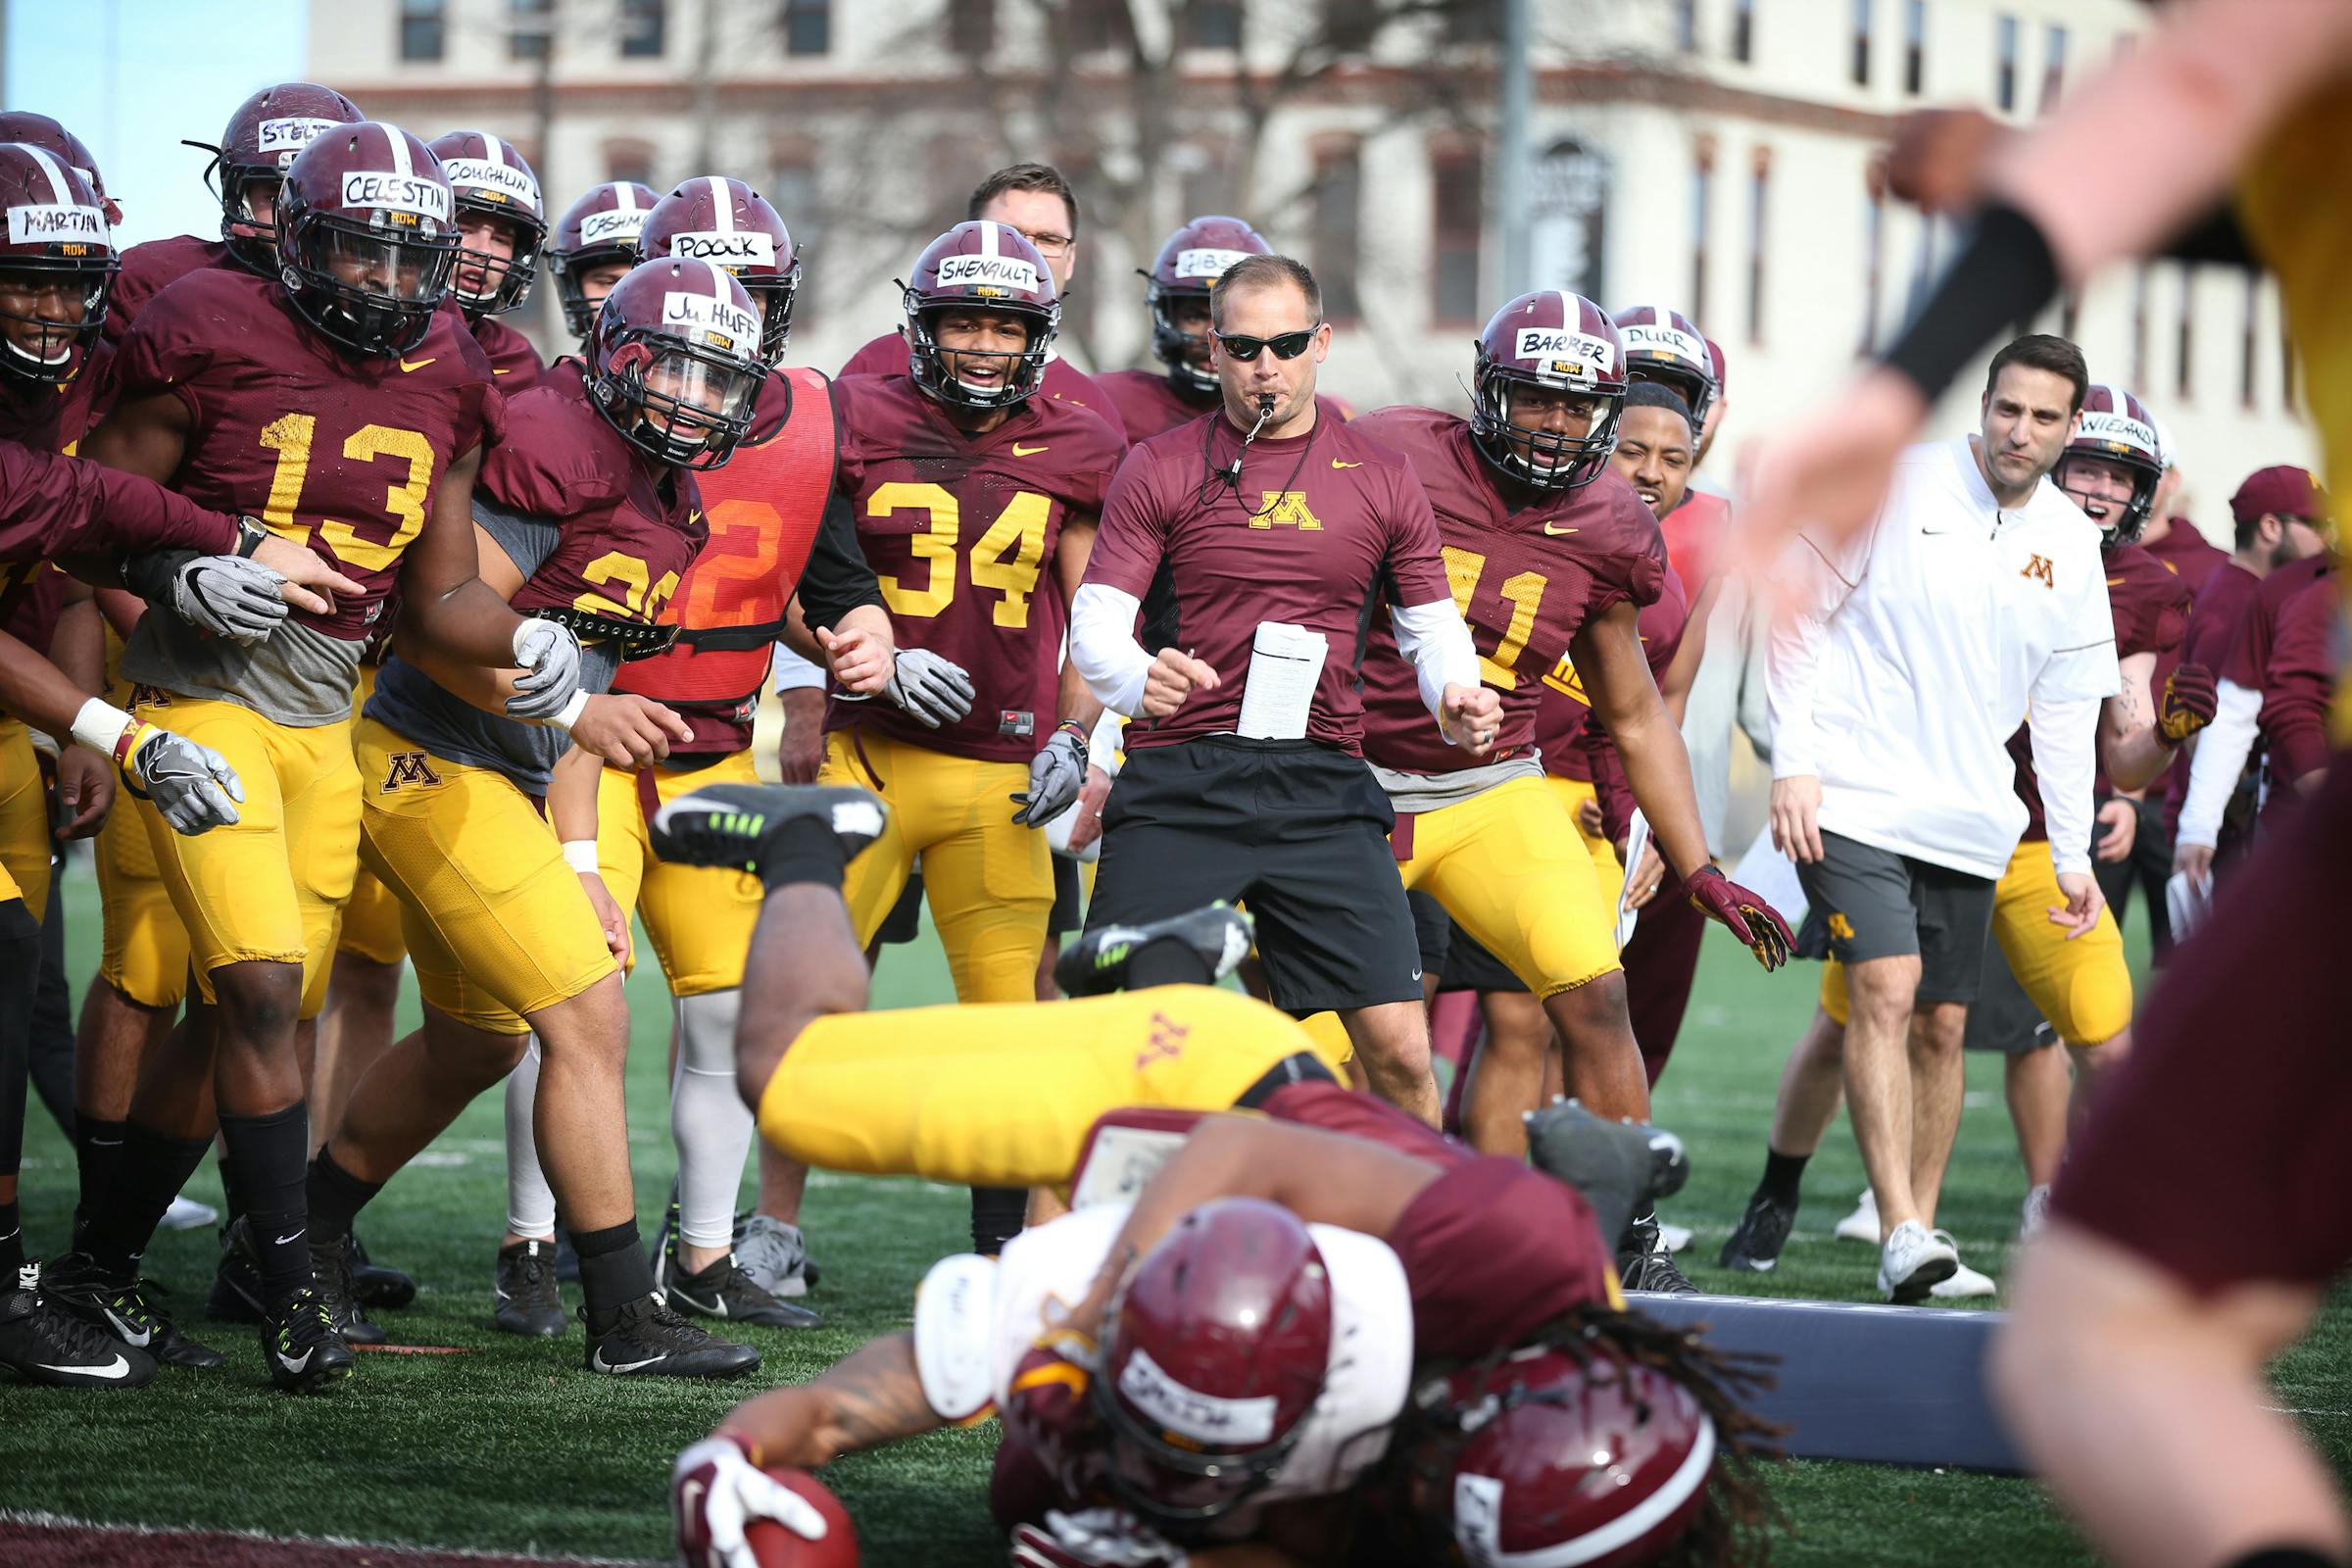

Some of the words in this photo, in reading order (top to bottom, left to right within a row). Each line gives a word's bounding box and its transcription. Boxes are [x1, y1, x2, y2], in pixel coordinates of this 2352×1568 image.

[446, 162, 527, 193] COUGHLIN
[346, 176, 444, 214] CELESTIN
[24, 210, 99, 236] MARTIN
[391, 212, 417, 226] ROW
[586, 216, 648, 236] CASHM
[62, 243, 87, 257] ROW
[942, 259, 1033, 285] SHENAULT
[711, 303, 756, 339] HUFF
[707, 331, 732, 350] ROW
[1522, 332, 1605, 365] BARBER
[1629, 328, 1690, 354] DURR
[1554, 360, 1581, 374] ROW
[2081, 416, 2151, 446] WIELAND
[260, 413, 436, 572] 13
[1249, 491, 1322, 530] M
[866, 481, 1053, 629] 34
[2020, 552, 2054, 590] M
[380, 750, 443, 795] M
